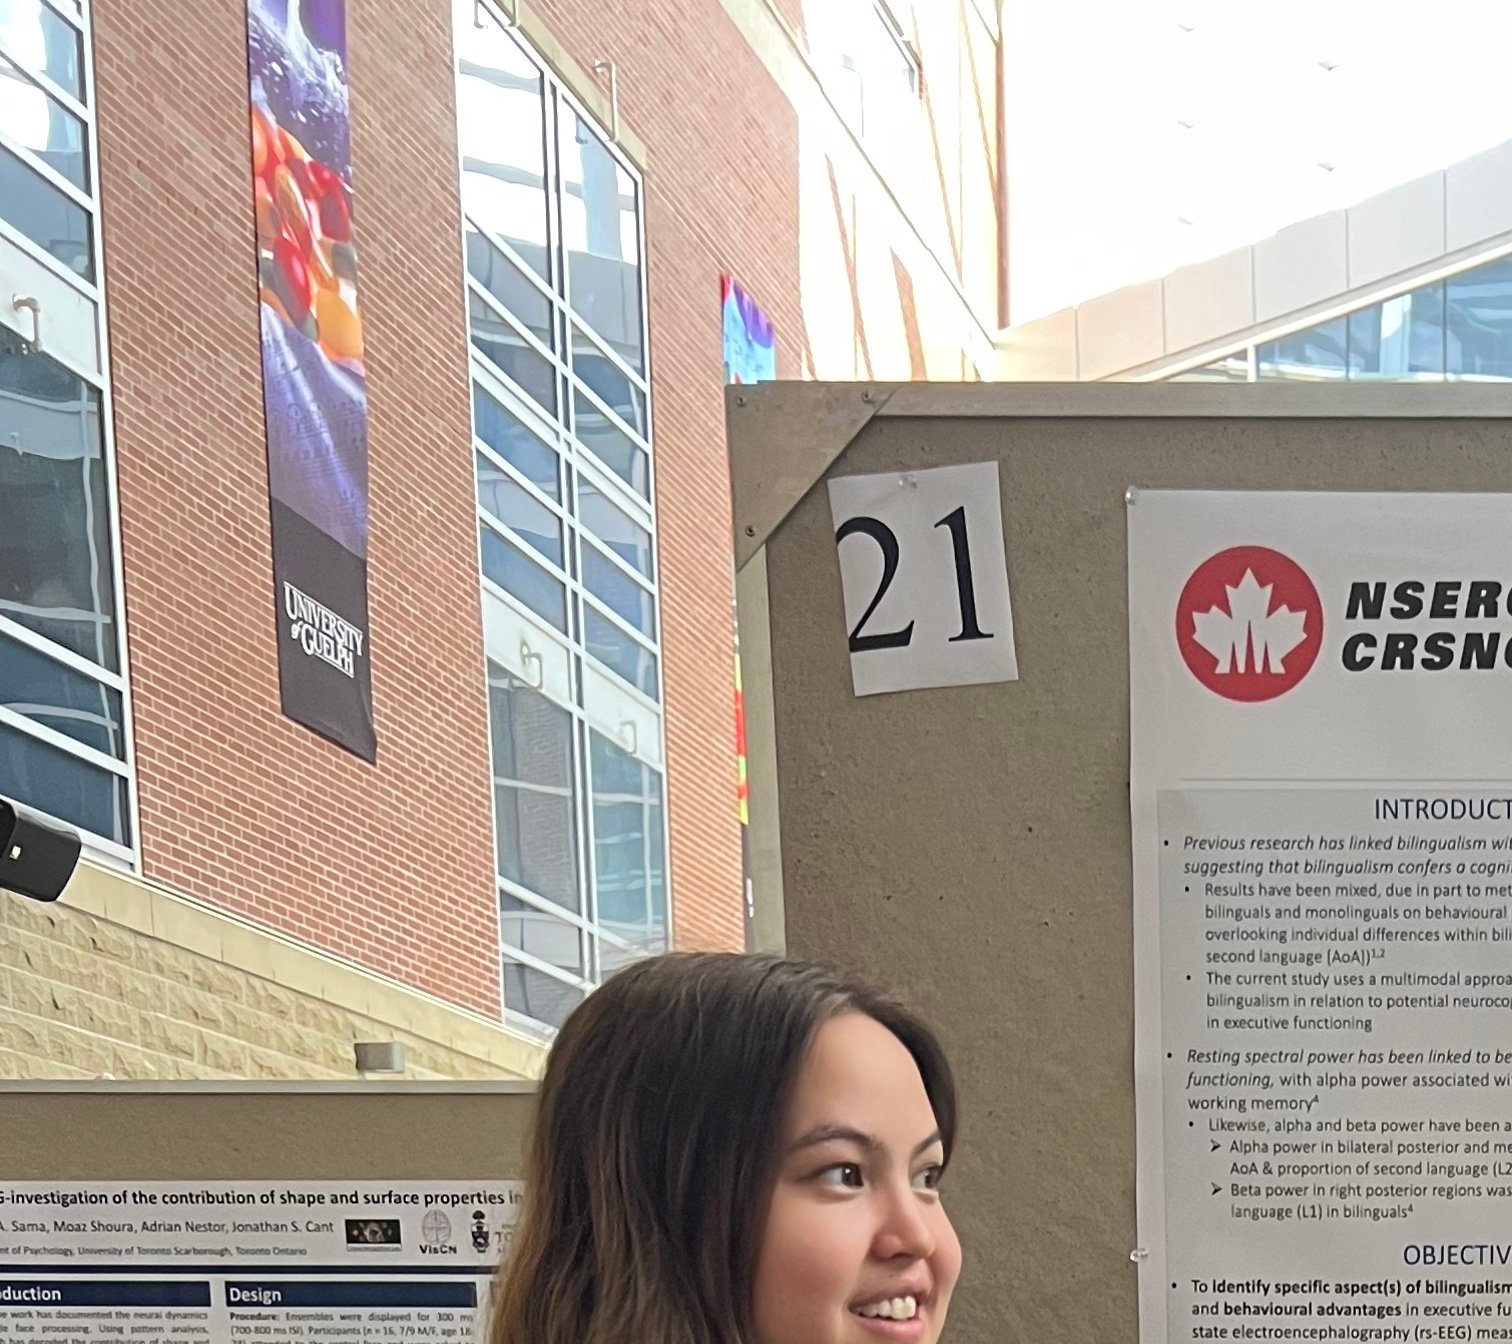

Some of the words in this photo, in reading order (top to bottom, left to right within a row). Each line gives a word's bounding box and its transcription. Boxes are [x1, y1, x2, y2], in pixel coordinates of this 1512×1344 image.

[835, 505, 995, 653] 21
[284, 585, 363, 657] UNIVERSITY
[291, 620, 304, 639] of
[301, 623, 355, 675] GUELPH
[1184, 835, 1245, 851] Previous
[1250, 835, 1314, 850] research
[1319, 835, 1345, 850] has
[1349, 835, 1393, 850] linked
[1397, 835, 1486, 854] bilingualism
[112, 1190, 127, 1204] of
[132, 1190, 157, 1204] the
[162, 1190, 255, 1204] contribution
[260, 1190, 275, 1204] of
[280, 1190, 325, 1207] shape
[330, 1190, 359, 1204] and
[363, 1190, 419, 1204] surface
[424, 1190, 505, 1208] properties
[11, 1220, 50, 1234] Sama,
[54, 1221, 87, 1232] Moaz
[91, 1220, 137, 1234] Shoura,
[141, 1221, 181, 1232] Adrian
[185, 1221, 229, 1234] Nestor,
[232, 1221, 288, 1232] Jonathan
[291, 1221, 302, 1232] S.
[305, 1221, 334, 1232] Cant
[1, 1286, 61, 1301] duction
[230, 1287, 281, 1304] Design
[1191, 1279, 1208, 1293] To
[1213, 1279, 1270, 1296] identify
[1275, 1280, 1330, 1296] specific
[1335, 1279, 1401, 1297] aspect(s)
[1406, 1280, 1421, 1294] of
